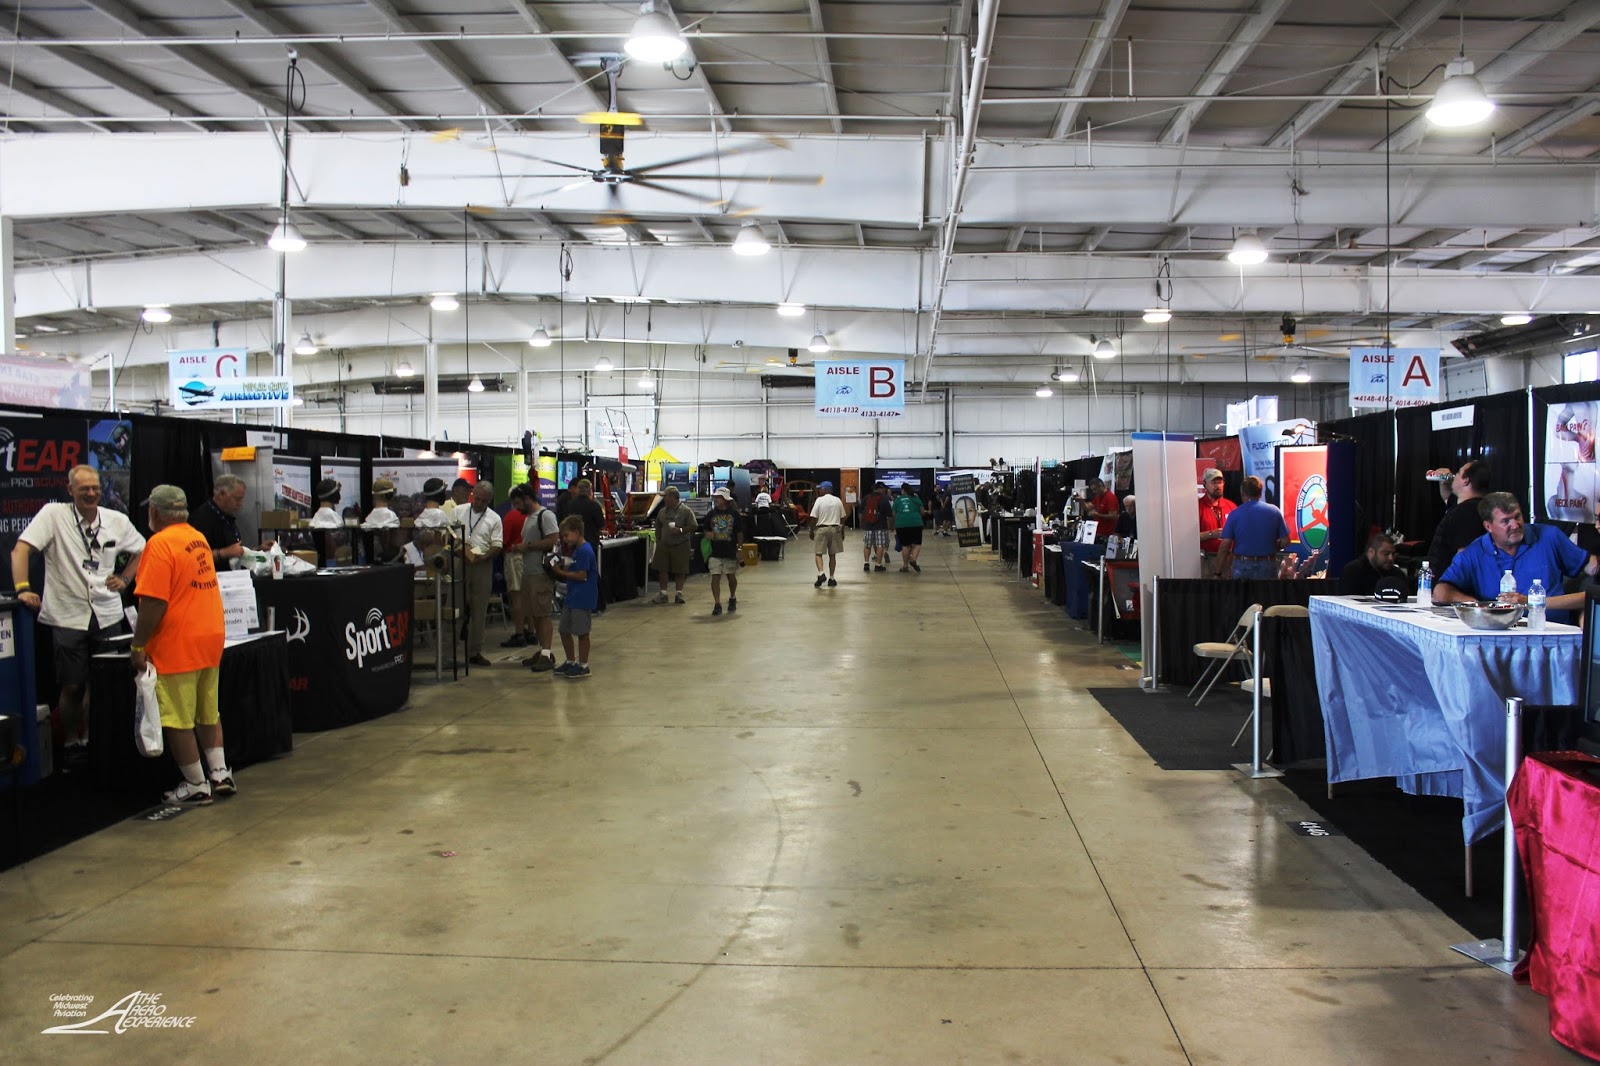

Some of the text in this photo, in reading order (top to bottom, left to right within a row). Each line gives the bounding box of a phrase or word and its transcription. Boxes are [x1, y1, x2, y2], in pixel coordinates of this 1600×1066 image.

[180, 356, 207, 364] AISLE
[1362, 355, 1395, 363] AISLE
[827, 366, 860, 374] AISLE
[1402, 356, 1432, 386] A
[869, 366, 896, 398] B
[824, 406, 859, 414] 4118-4132
[1569, 419, 1588, 431] PAIN?
[1555, 498, 1587, 508] NECK PAIN?
[223, 606, 244, 614] Welding
